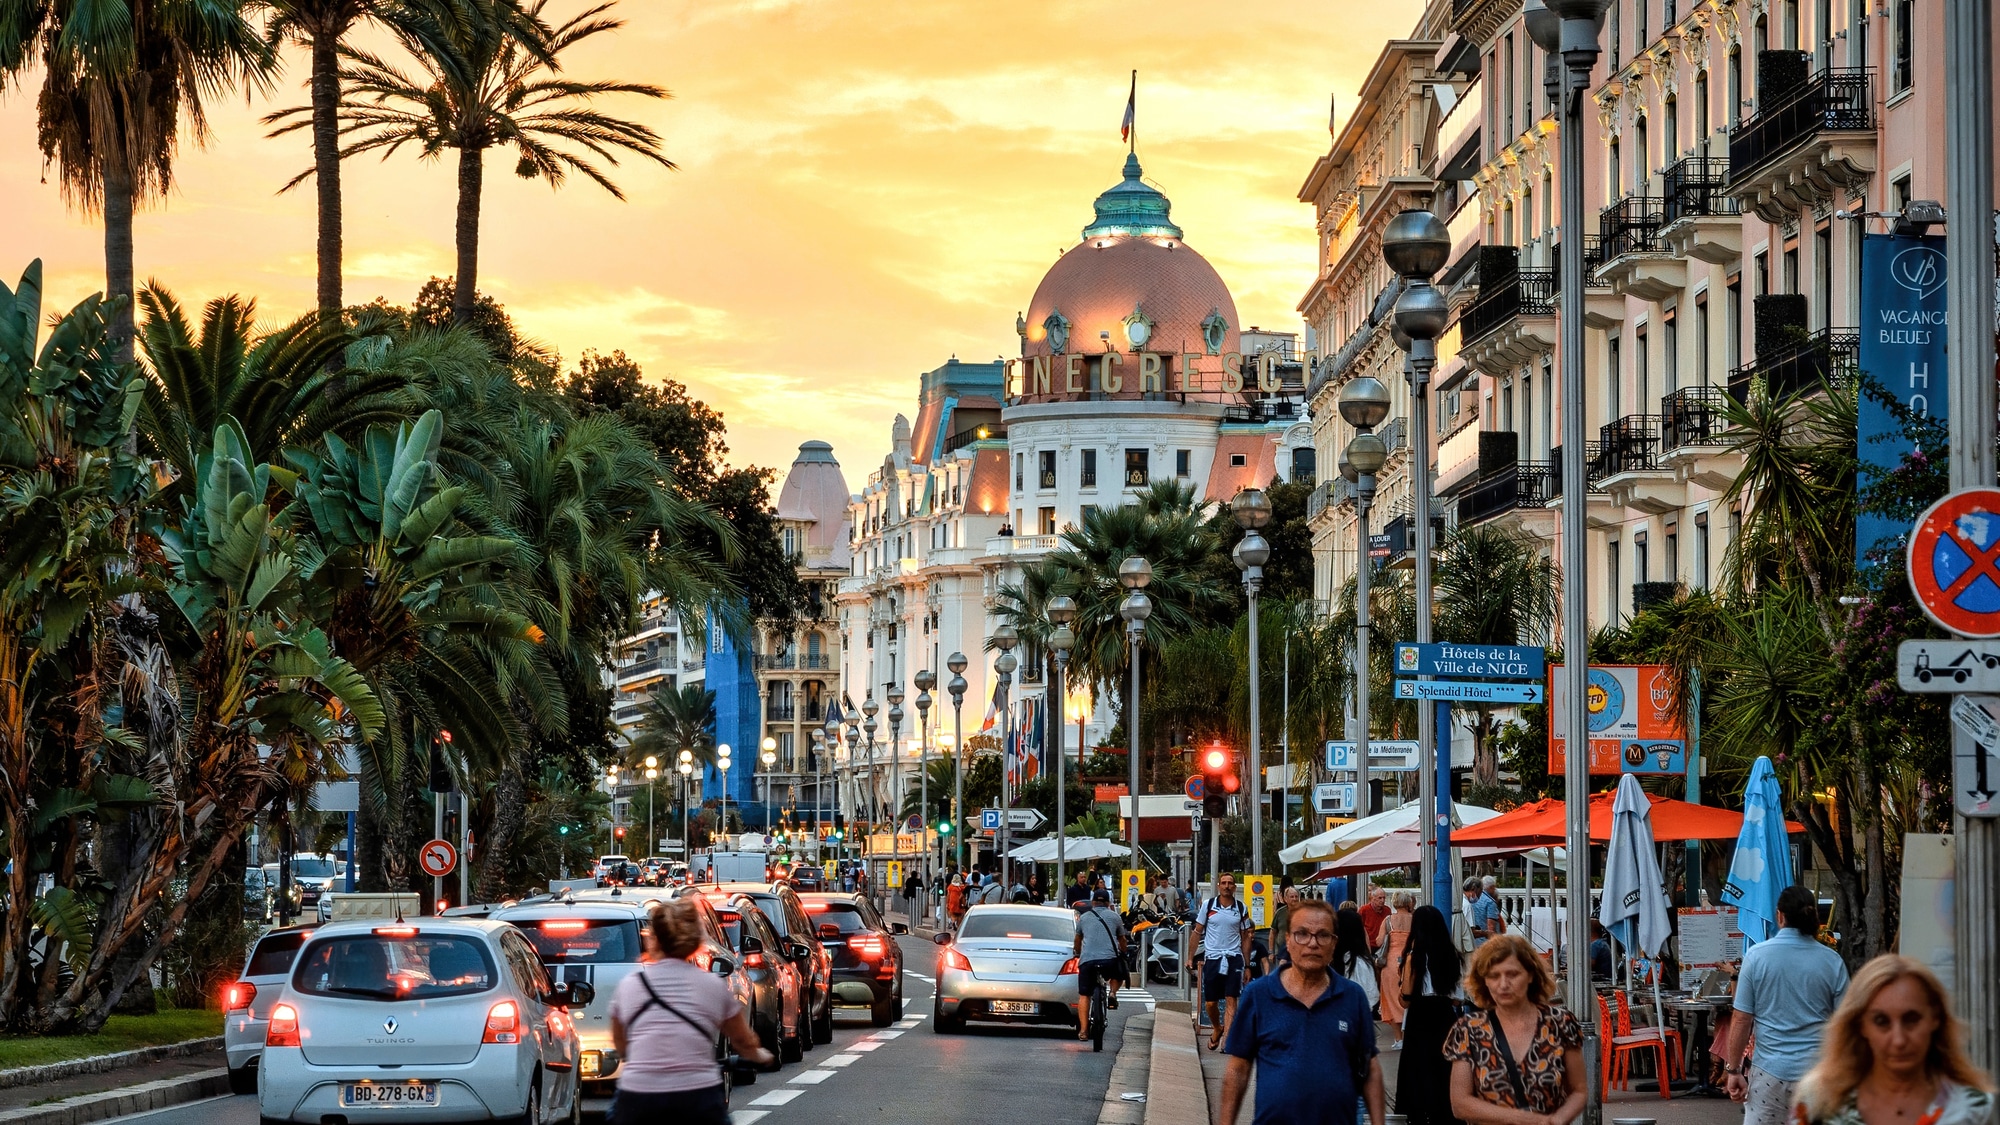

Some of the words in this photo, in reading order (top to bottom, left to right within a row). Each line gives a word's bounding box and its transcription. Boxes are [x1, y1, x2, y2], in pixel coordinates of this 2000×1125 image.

[1879, 330, 1932, 345] BLEUES
[1441, 646, 1486, 660] Hôtels
[1489, 648, 1506, 661] de
[1509, 649, 1521, 661] la
[1433, 660, 1464, 674] Ville
[1467, 662, 1484, 674] de
[1487, 662, 1529, 676] NICE
[1418, 685, 1461, 699] Splendid
[1464, 687, 1492, 698] Hôtel
[355, 1086, 425, 1101] BD-278-GX
